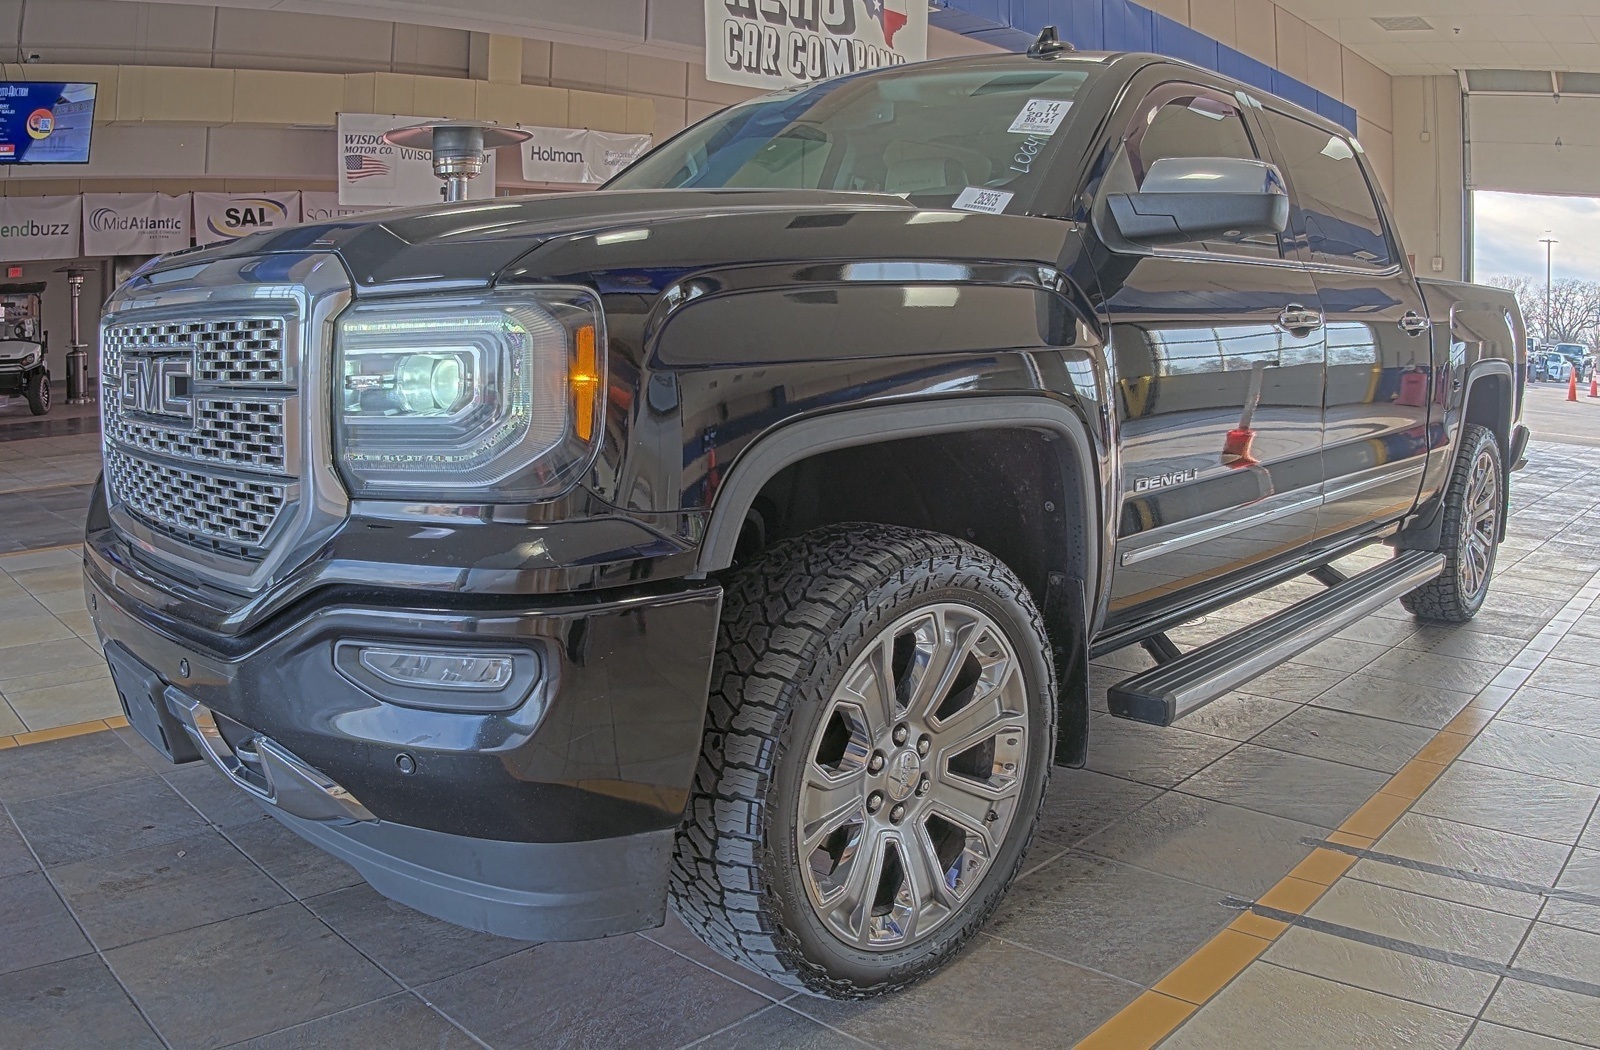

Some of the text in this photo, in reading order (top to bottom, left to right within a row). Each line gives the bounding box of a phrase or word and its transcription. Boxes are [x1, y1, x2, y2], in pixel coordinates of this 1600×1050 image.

[723, 19, 782, 77] CAR
[1027, 102, 1060, 112] C 14
[344, 134, 389, 146] WISDO
[343, 146, 394, 154] MOTOR CO.
[531, 145, 585, 163] Holman
[224, 207, 273, 228] SAL
[121, 356, 192, 418] GMC
[1133, 468, 1198, 492] DENALI
